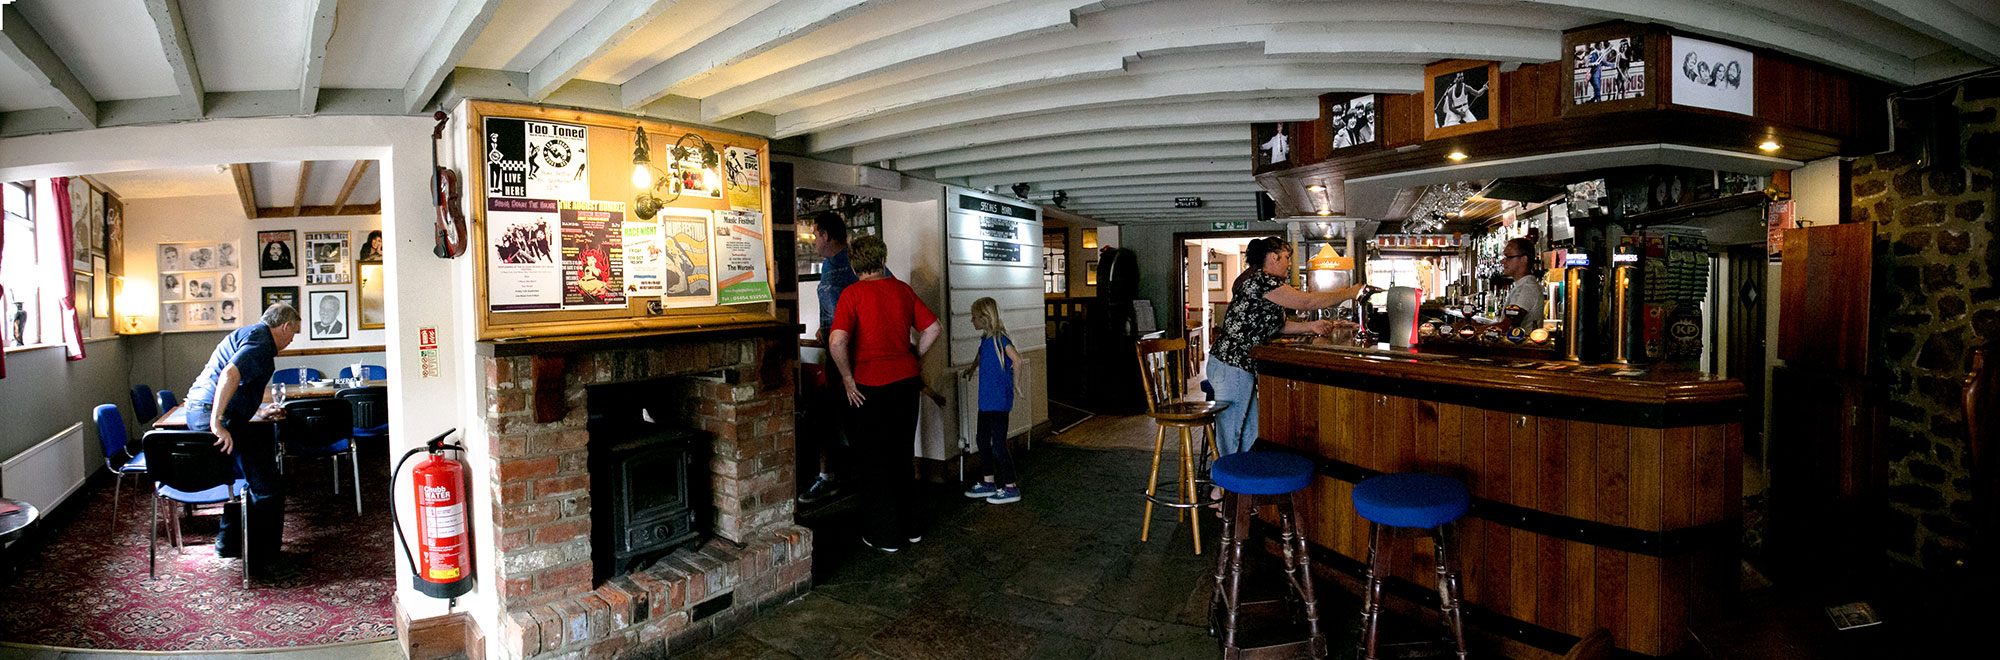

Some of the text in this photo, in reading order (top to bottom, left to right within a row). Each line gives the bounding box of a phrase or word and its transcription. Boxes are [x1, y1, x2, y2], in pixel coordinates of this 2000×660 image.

[528, 123, 549, 134] Too
[552, 125, 585, 139] Toned
[744, 162, 758, 171] EPIC
[504, 173, 521, 184] LIVE
[504, 186, 525, 197] HERE
[559, 201, 572, 210] THE
[573, 201, 597, 211] AUGUST
[980, 201, 998, 213] SPECIALS
[723, 216, 756, 225] Music Festival
[624, 226, 657, 238] RACE NIGHT
[1676, 324, 1696, 335] KP
[423, 485, 446, 494] Chubb
[424, 491, 451, 500] WATER
